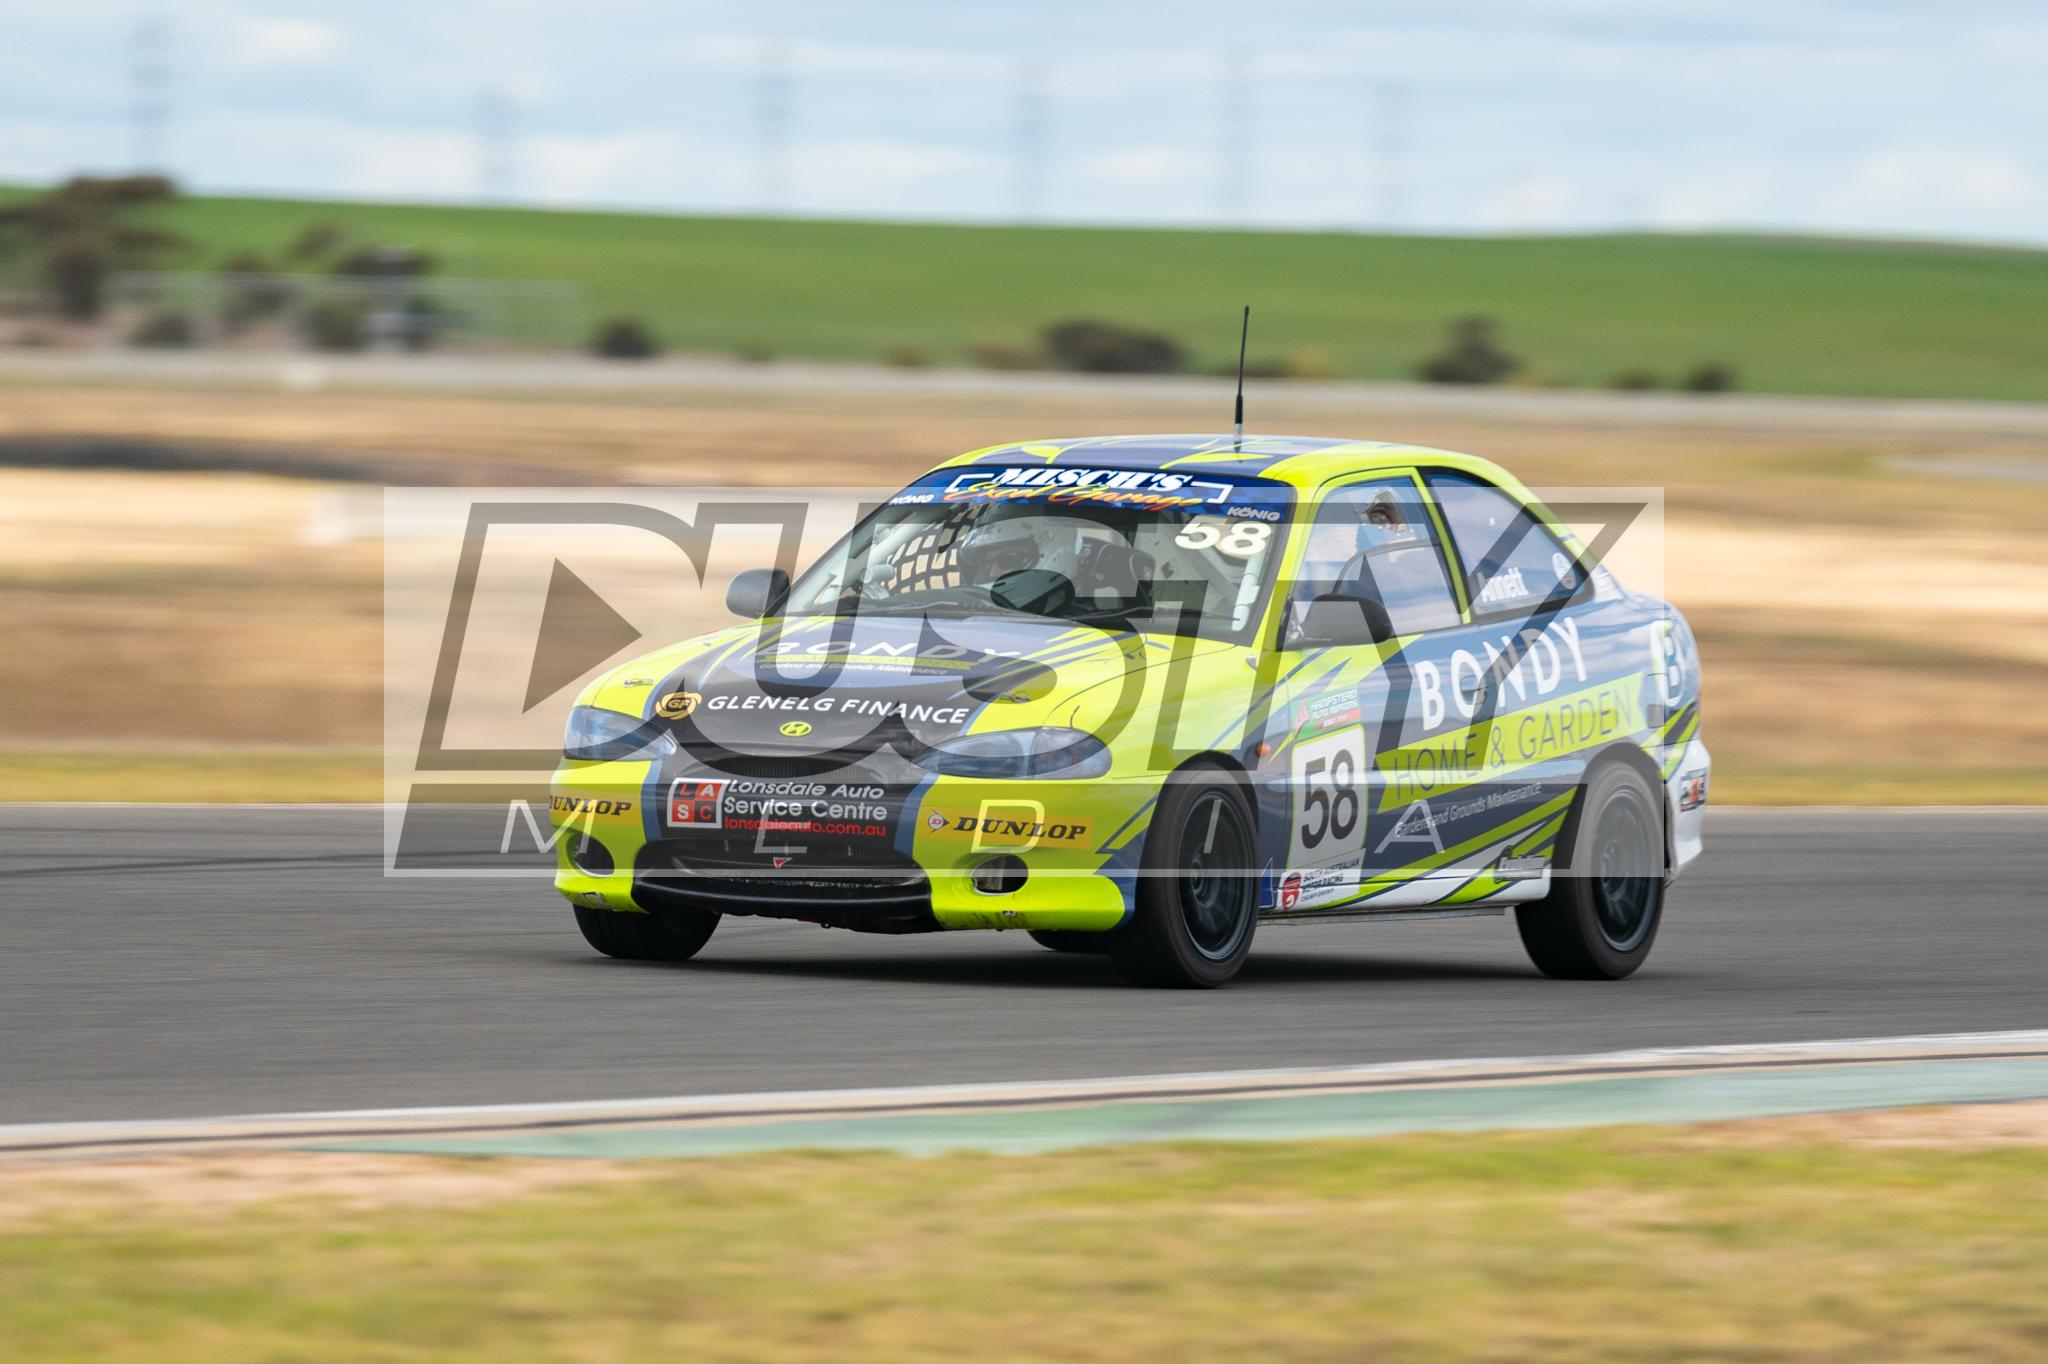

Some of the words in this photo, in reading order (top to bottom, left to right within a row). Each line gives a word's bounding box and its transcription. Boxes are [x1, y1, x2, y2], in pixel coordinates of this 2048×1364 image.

[944, 481, 1044, 502] Excel
[995, 467, 1195, 492] MISCH'S
[1226, 506, 1281, 521] KÖNIG
[1175, 514, 1272, 557] 58
[756, 641, 1021, 664] BONDY
[1414, 616, 1587, 730] BONDY
[707, 695, 836, 712] GLENELG
[840, 699, 969, 724] FINANCE
[1393, 732, 1478, 799] HOME
[1489, 725, 1505, 767] &
[1518, 684, 1633, 761] GARDEN
[727, 779, 827, 798] Lonsdale
[831, 784, 885, 800] Auto
[1301, 748, 1358, 850] 58
[1450, 798, 1486, 821] Grounds
[1487, 781, 1542, 811] Maintenance
[724, 796, 803, 817] Service
[811, 799, 888, 821] Centre
[724, 816, 887, 836] lonsdaleauto.com.au
[953, 816, 1087, 840] DUNLOP
